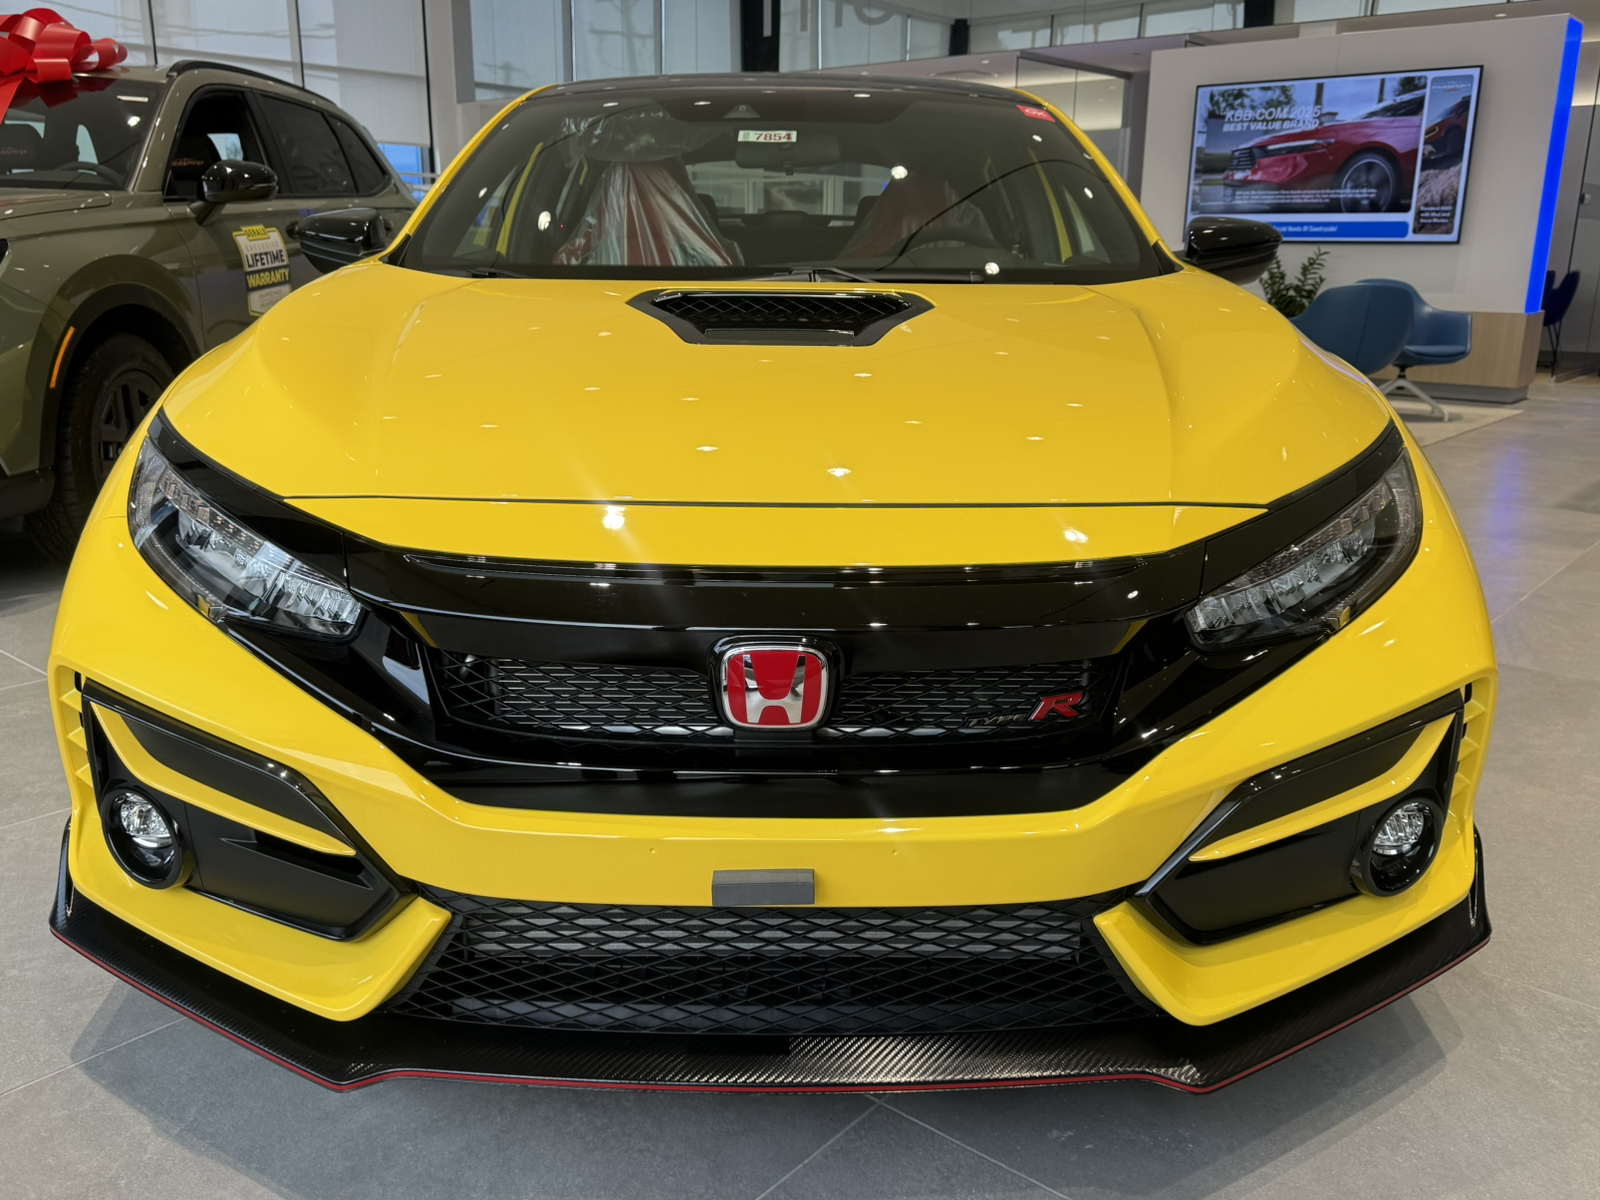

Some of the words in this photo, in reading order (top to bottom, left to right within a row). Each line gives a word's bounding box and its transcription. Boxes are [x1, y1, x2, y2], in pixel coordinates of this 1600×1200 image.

[1289, 106, 1322, 118] 2025
[1223, 123, 1250, 132] BEST
[1250, 120, 1282, 131] VALUE
[1283, 119, 1320, 130] BRAND
[754, 132, 793, 141] 7854
[245, 249, 285, 268] LIFETIME
[246, 269, 290, 288] WARRANTY
[1028, 691, 1084, 721] R
